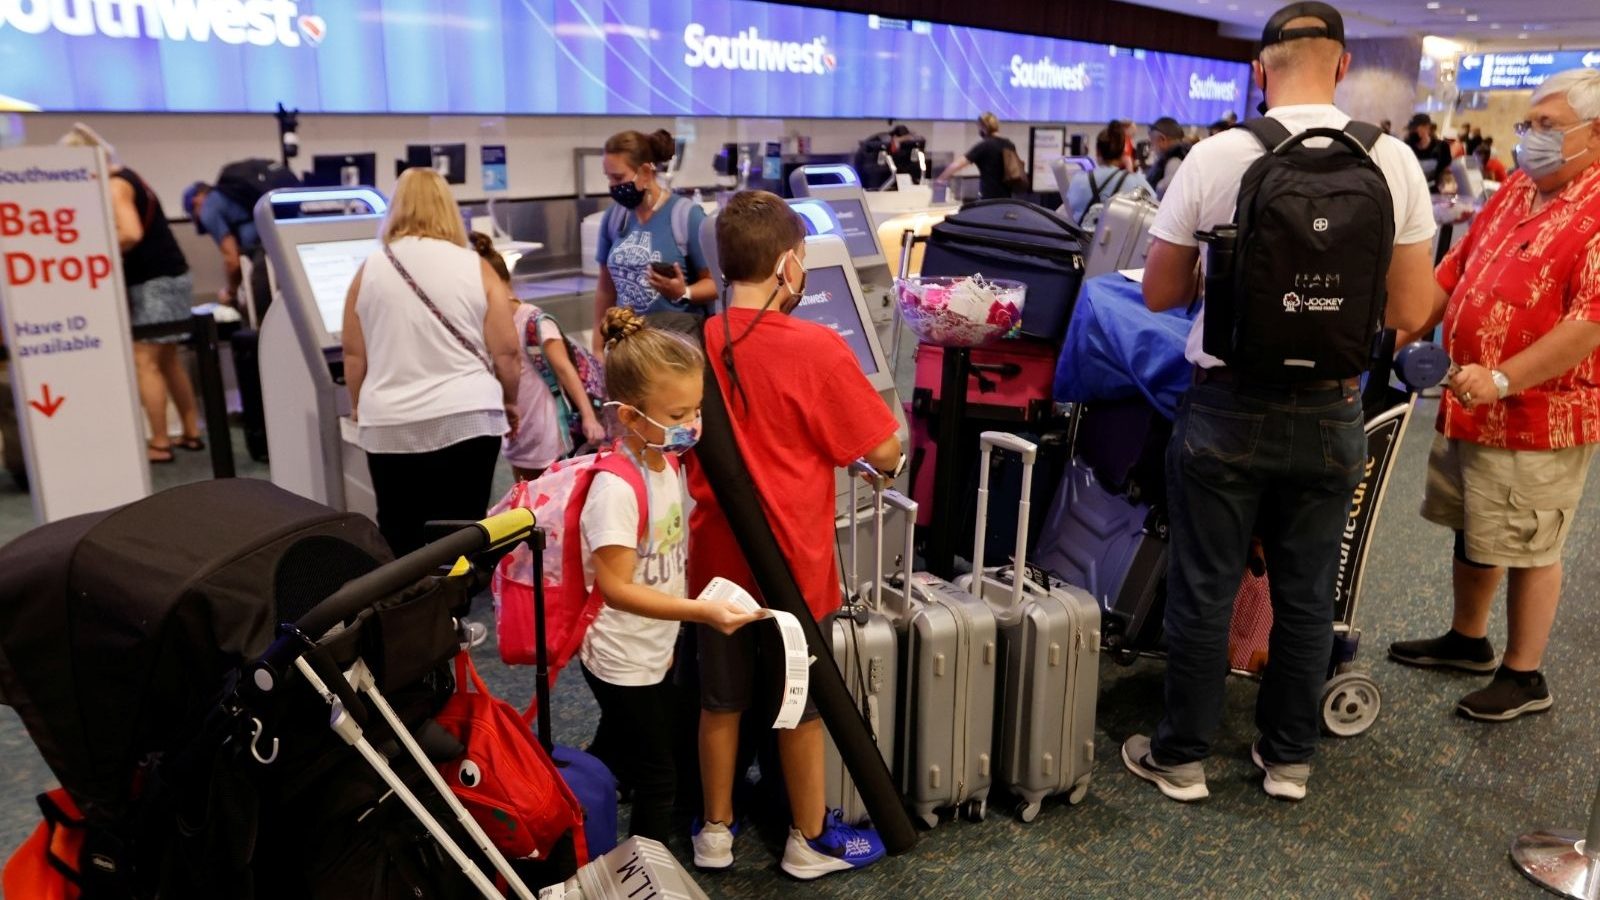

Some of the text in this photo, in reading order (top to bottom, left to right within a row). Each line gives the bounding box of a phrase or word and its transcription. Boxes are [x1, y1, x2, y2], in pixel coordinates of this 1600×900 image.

[0, 0, 301, 47] outhwest
[684, 23, 826, 75] Southwest
[1010, 54, 1086, 91] Southwest
[1189, 72, 1237, 102] Southwest
[0, 202, 79, 244] Bag
[5, 251, 112, 289] Drop
[1304, 297, 1344, 306] JOCKEY
[14, 315, 87, 337] Have ID
[19, 335, 101, 357] available
